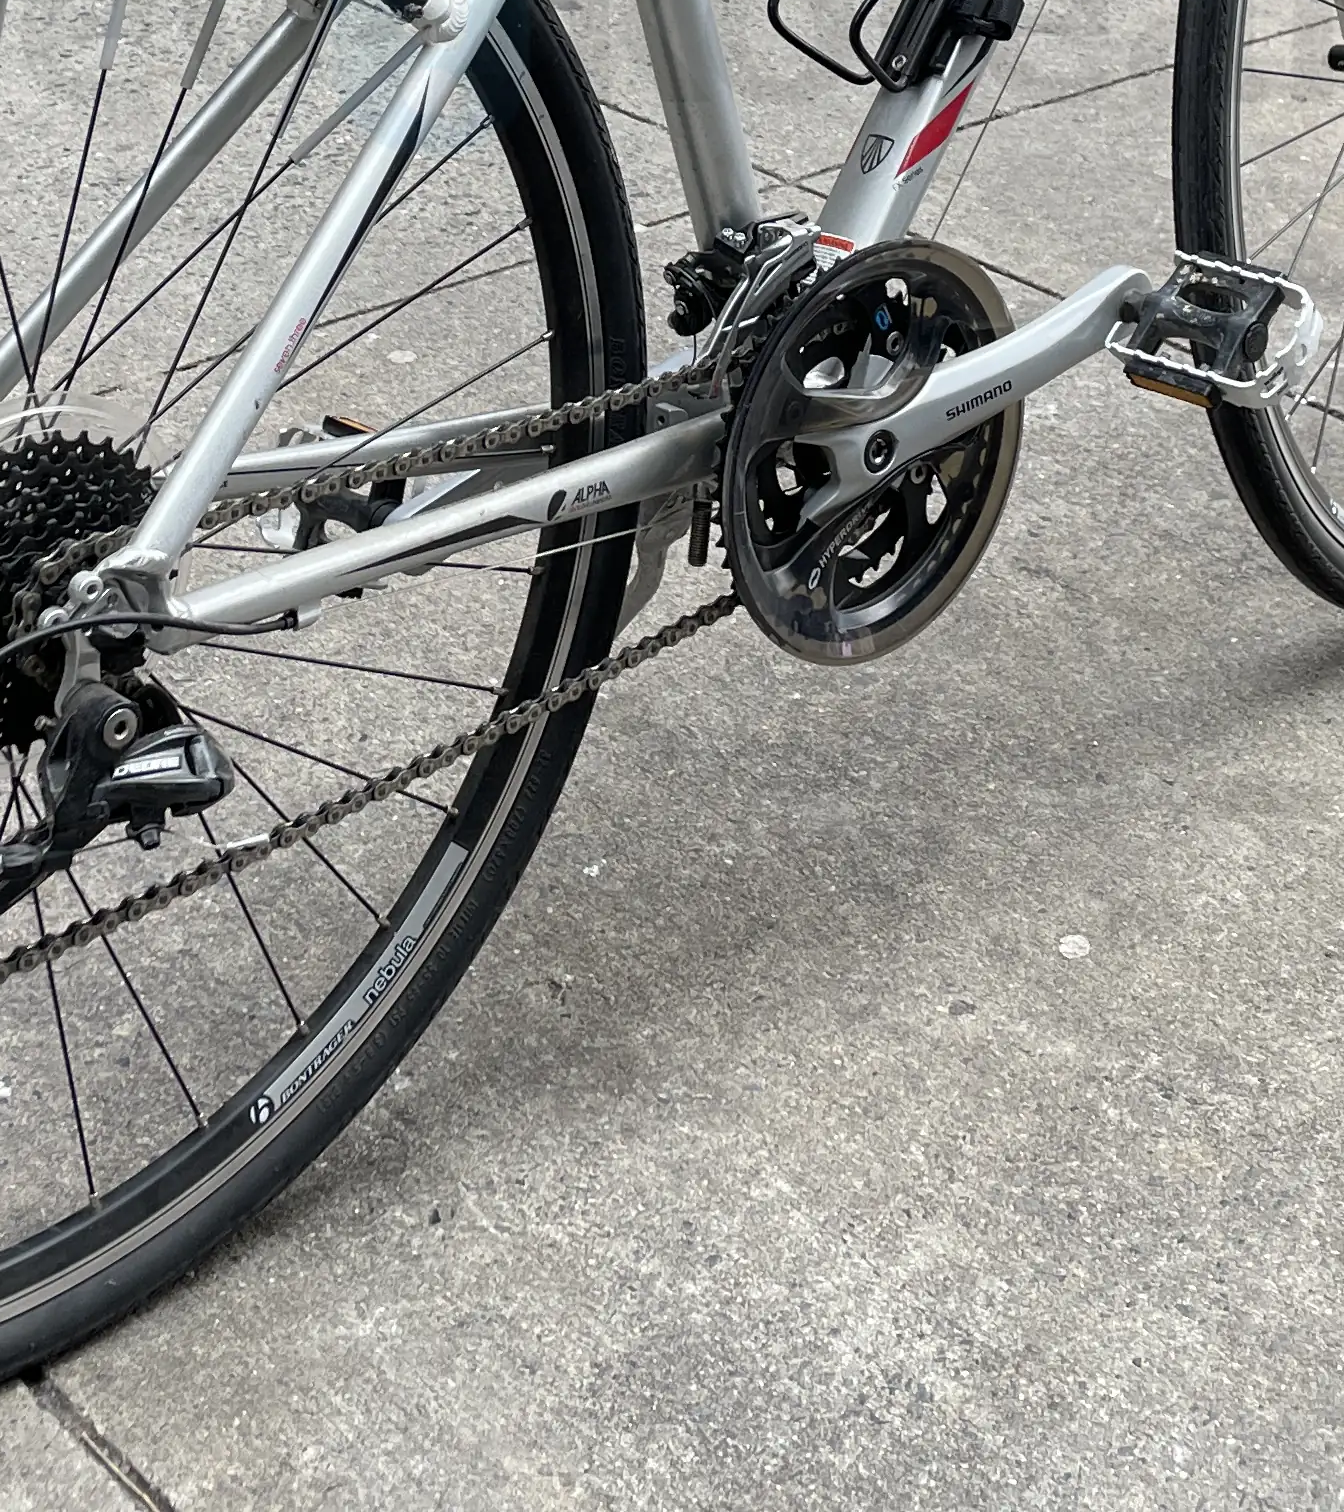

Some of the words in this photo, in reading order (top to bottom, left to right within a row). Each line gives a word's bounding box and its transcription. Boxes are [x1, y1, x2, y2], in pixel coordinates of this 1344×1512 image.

[945, 379, 1012, 422] SHIMANO
[571, 480, 611, 506] ALPHA
[280, 1019, 357, 1105] BONTRAGER
[362, 935, 417, 1007] nebula
